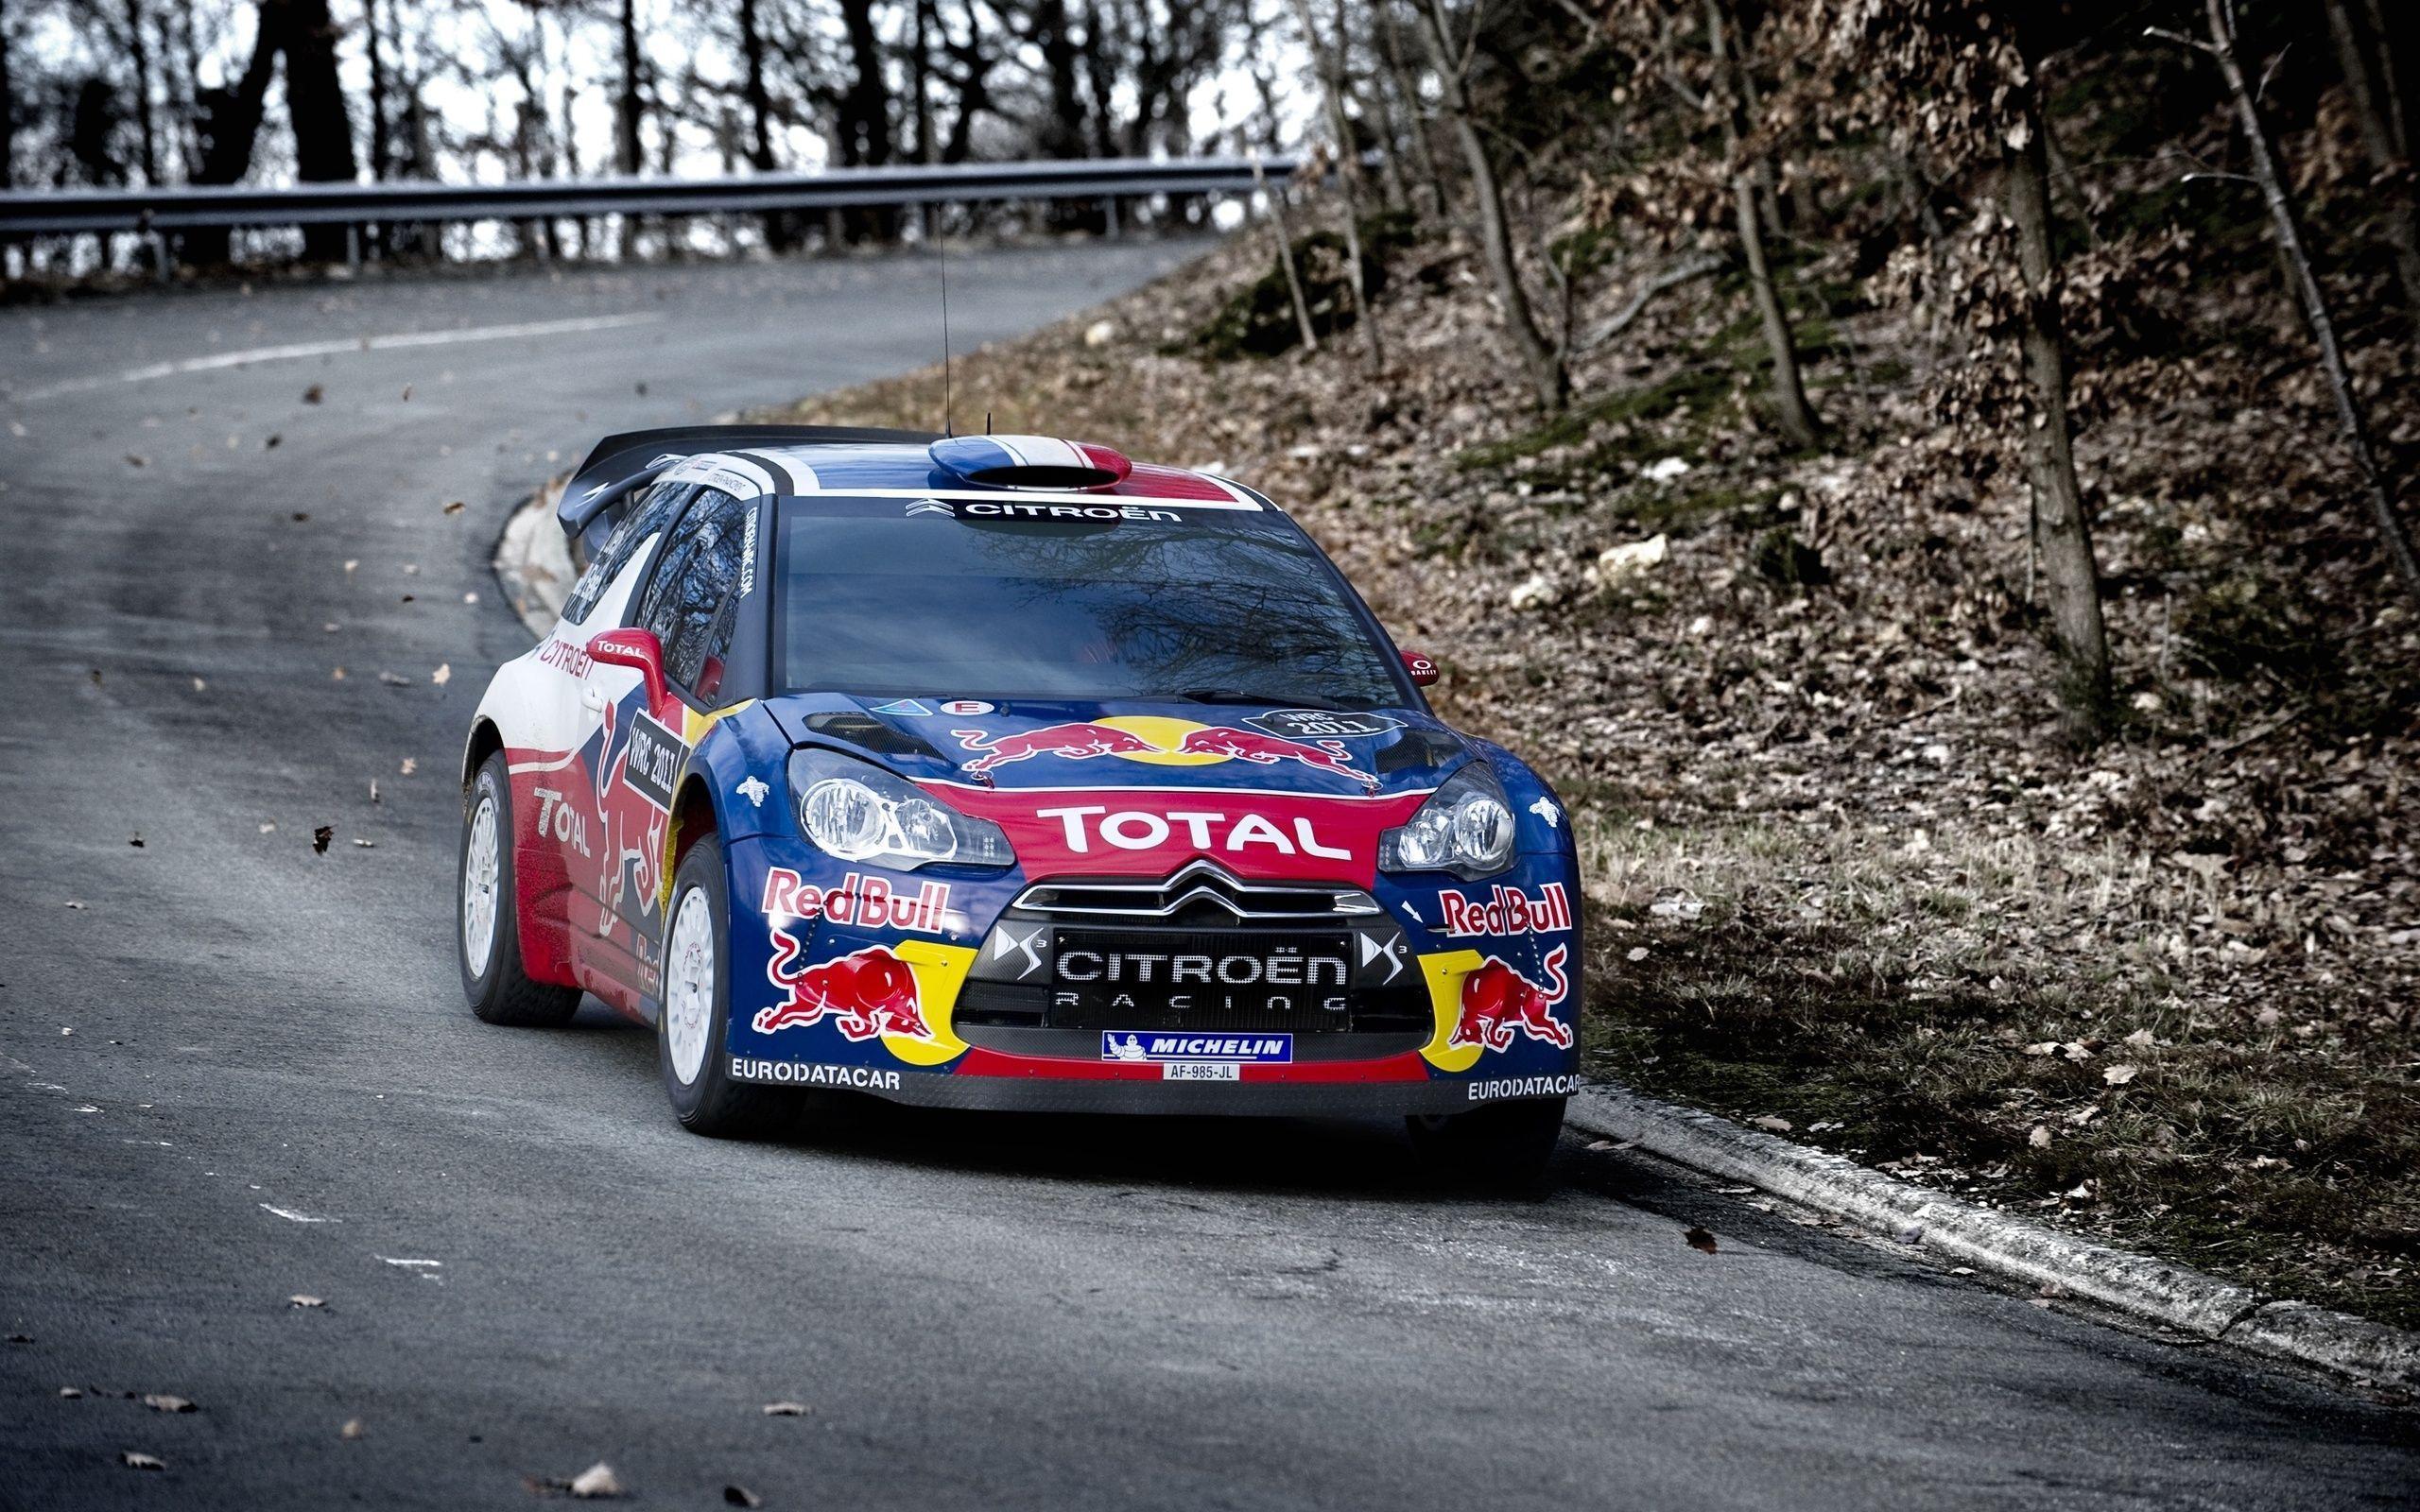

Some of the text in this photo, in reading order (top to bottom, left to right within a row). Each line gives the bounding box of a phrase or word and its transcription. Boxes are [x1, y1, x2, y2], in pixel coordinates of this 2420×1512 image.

[596, 640, 645, 659] TOTAL
[955, 702, 980, 713] E
[1279, 713, 1335, 722] WRC
[1287, 720, 1381, 735] 2011
[630, 727, 676, 794] WRC 2011
[533, 787, 591, 858] TOTAL
[1037, 805, 1353, 861] TOTAL
[1056, 991, 1347, 1011] RACING
[1150, 1038, 1284, 1055] MICHELIN
[732, 1057, 901, 1091] EURODATACAR
[1170, 1065, 1233, 1078] AF-985-JL
[1468, 1074, 1580, 1101] EURODATACAR
